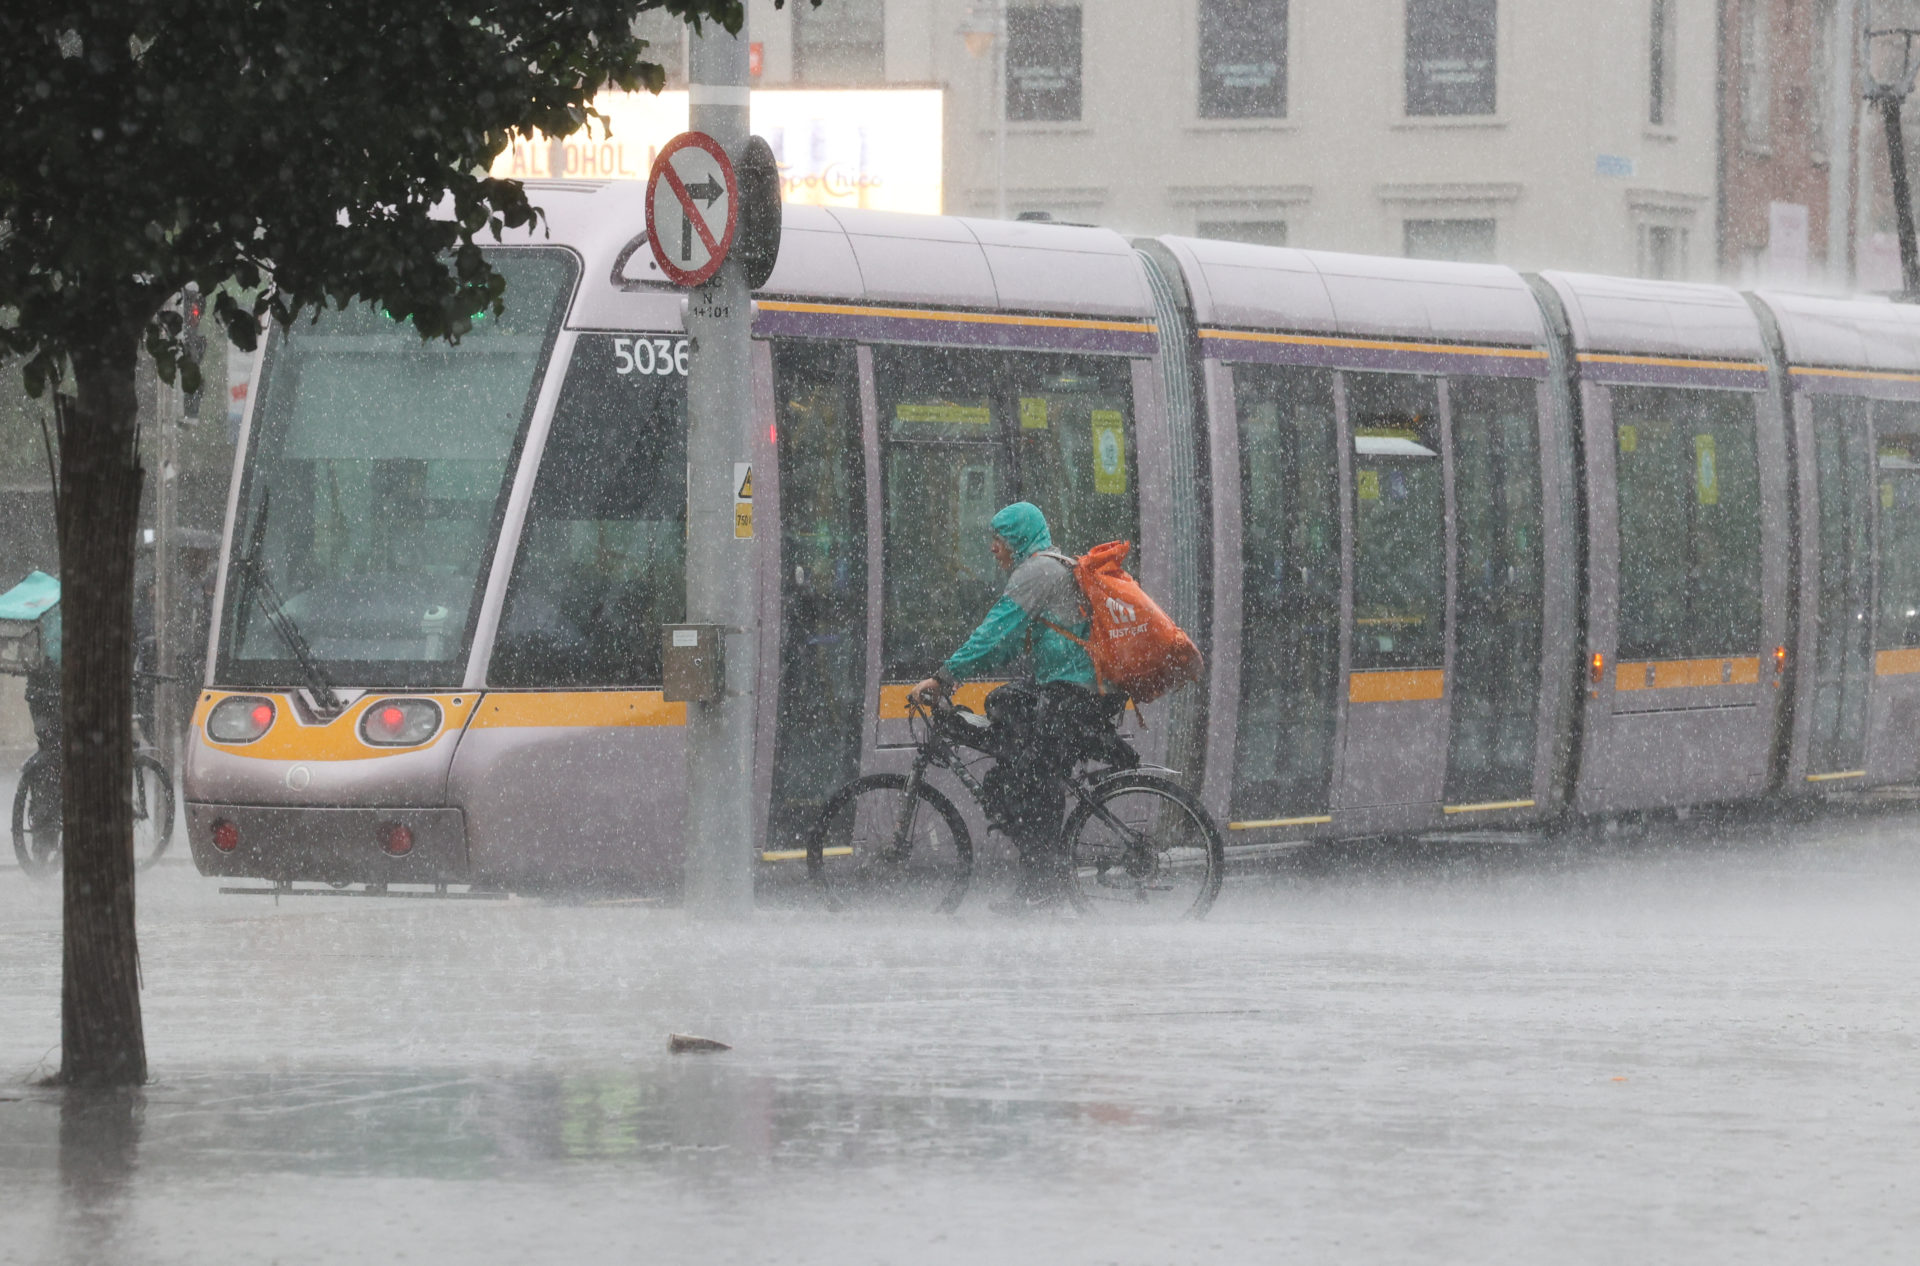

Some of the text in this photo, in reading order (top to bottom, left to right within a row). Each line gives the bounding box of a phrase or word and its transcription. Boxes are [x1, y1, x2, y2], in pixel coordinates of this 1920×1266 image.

[823, 161, 884, 197] Chico
[614, 338, 688, 376] 5036
[1108, 628, 1129, 639] JUST
